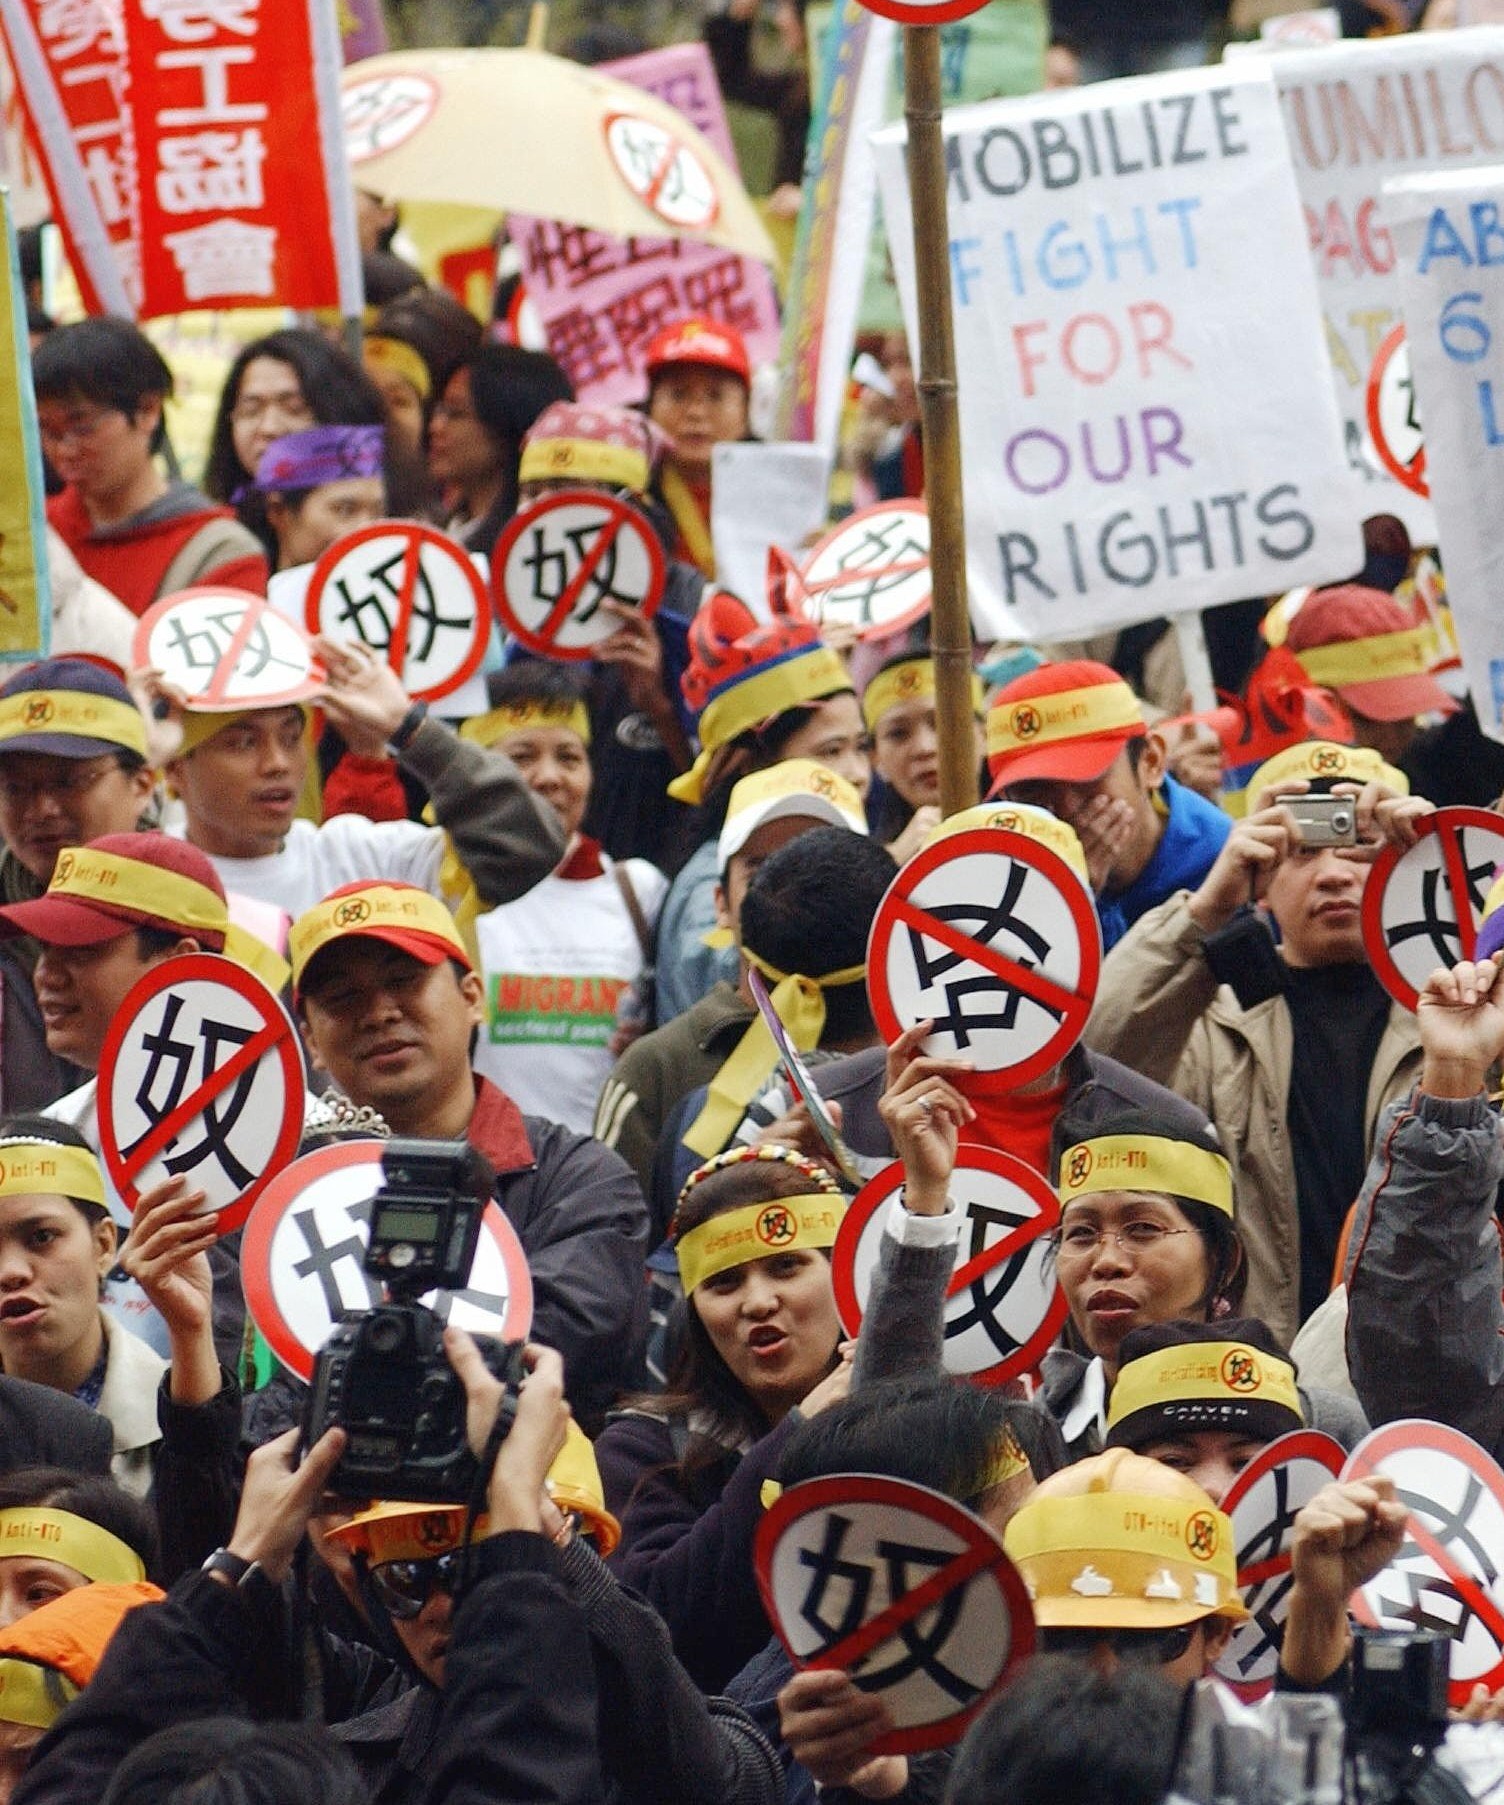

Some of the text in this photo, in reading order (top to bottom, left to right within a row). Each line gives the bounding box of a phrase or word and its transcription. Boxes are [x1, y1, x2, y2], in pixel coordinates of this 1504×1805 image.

[948, 199, 1202, 306] FIGHT
[1011, 300, 1194, 399] FOR
[1438, 291, 1493, 364] 6
[1004, 406, 1194, 495] OUR
[523, 522, 640, 624] 奴
[997, 484, 1316, 607] RIGHTS
[167, 607, 306, 681] 奴
[336, 550, 471, 662] 奴
[908, 860, 1067, 1049] 奴
[119, 992, 262, 1192] 奴
[1096, 1151, 1149, 1169] Anti-WTO
[762, 1205, 792, 1239] 奴
[1229, 1355, 1254, 1384] 奴
[7, 1522, 63, 1543] Anti-WTO
[799, 1513, 987, 1706] 奴
